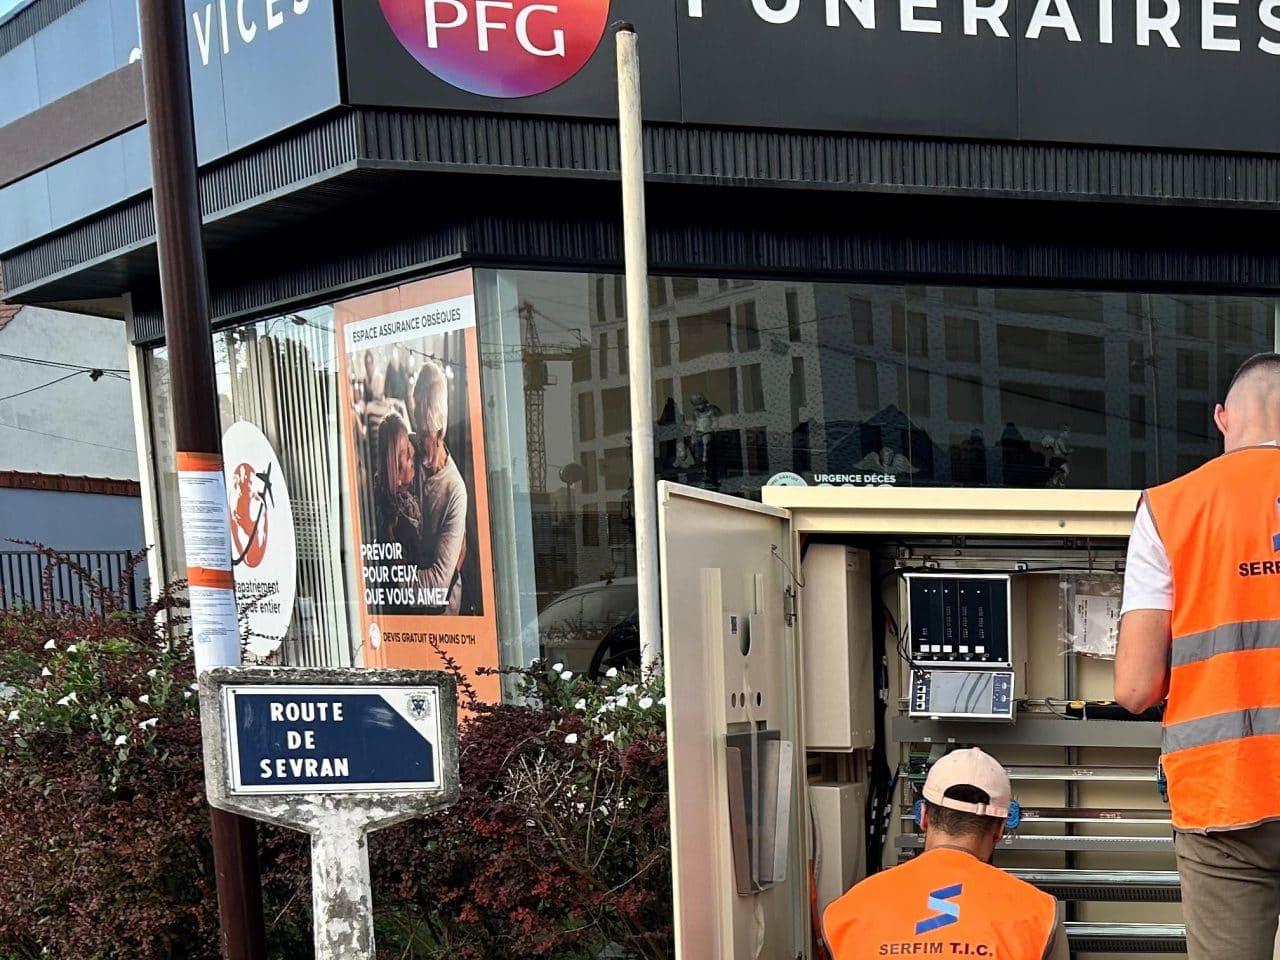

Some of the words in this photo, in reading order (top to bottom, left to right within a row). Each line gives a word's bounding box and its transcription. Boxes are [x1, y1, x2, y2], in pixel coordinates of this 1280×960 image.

[424, 0, 566, 58] PFG
[352, 326, 379, 343] ESPACE
[379, 317, 420, 337] ASSURANCE
[421, 307, 461, 328] OBSÈQUES
[814, 474, 862, 483] URGENCE
[863, 472, 897, 483] DÉCÈS
[360, 539, 403, 561] PRÉVOIR
[362, 566, 389, 583] POUR
[391, 565, 418, 582] CEUX
[364, 588, 385, 606] QUE
[386, 587, 415, 606] VOUS
[417, 587, 450, 606] AIMEZ
[260, 600, 280, 613] entier
[383, 632, 401, 642] DEVIS
[401, 632, 427, 643] GRATUIT
[428, 633, 438, 643] EN
[439, 633, 460, 644] MOINS
[270, 702, 344, 722] ROUTE
[287, 730, 316, 750] DE
[259, 757, 349, 778] SEVRAN
[879, 942, 943, 956] SERFIM
[949, 942, 994, 957] T.I.C.
